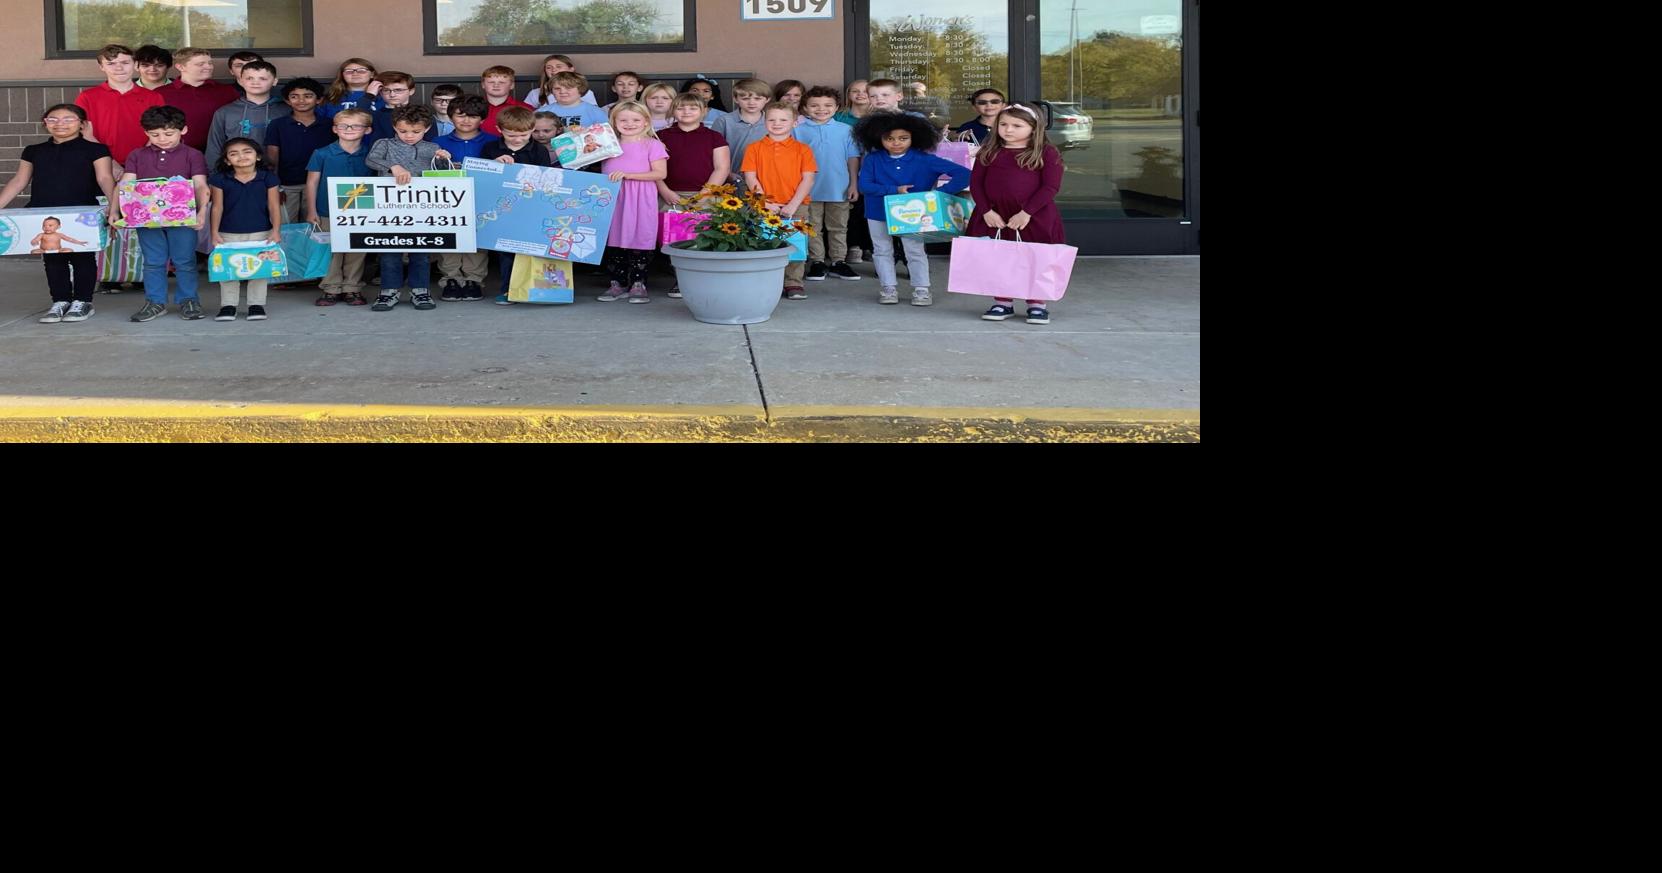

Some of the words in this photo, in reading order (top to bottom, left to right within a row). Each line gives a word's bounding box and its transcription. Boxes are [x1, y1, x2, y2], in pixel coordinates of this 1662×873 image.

[746, 0, 829, 14] 1509
[376, 185, 466, 208] Trinity
[336, 215, 468, 227] 217-442-4311
[363, 236, 414, 246] Grades
[416, 236, 444, 246] K-8
